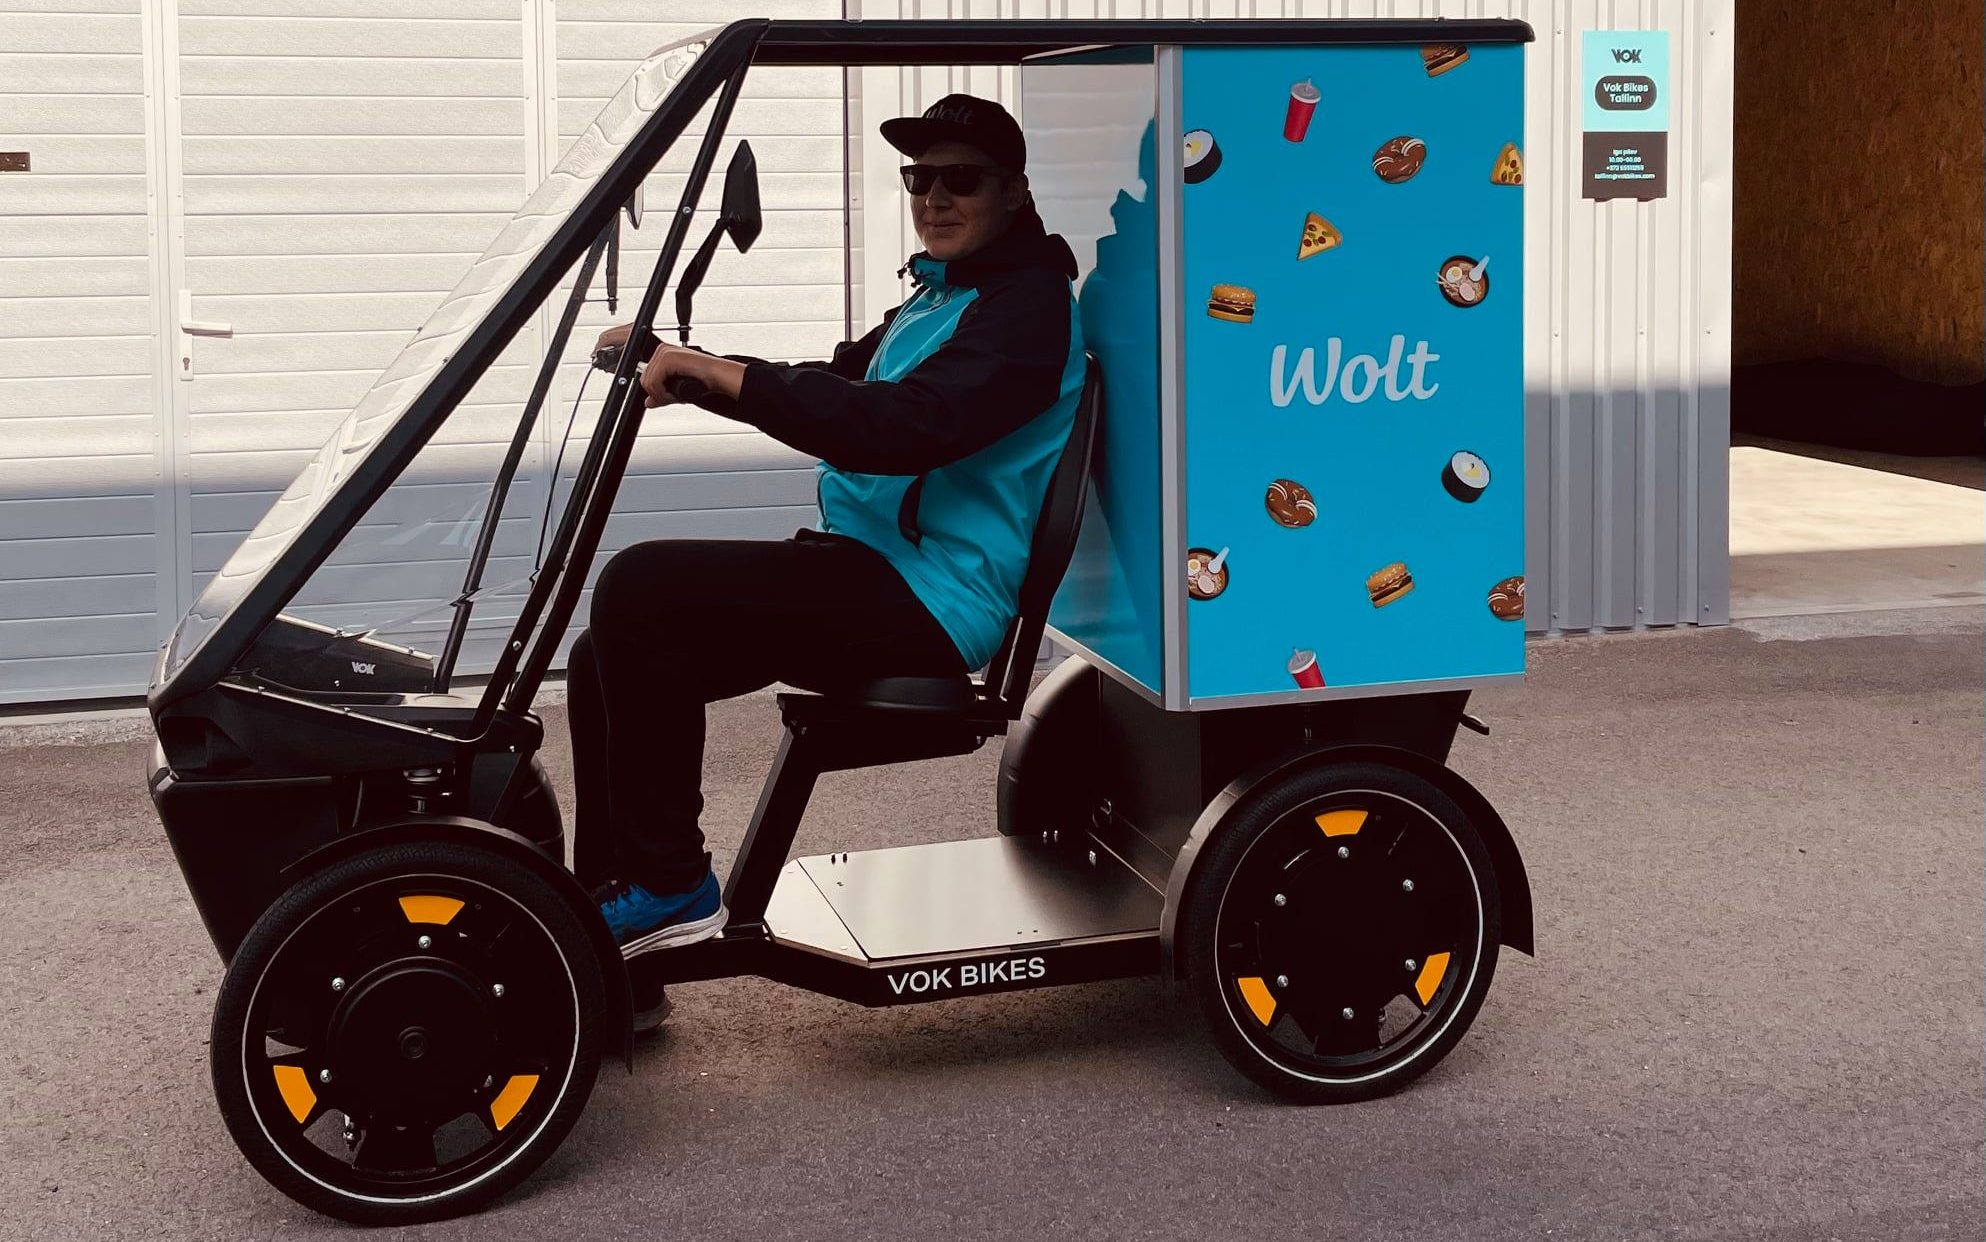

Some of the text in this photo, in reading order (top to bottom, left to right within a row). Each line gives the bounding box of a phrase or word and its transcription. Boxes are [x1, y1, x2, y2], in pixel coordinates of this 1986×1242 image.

[1611, 49, 1642, 63] VOK
[1603, 83, 1649, 92] Vok Bikes
[1610, 94, 1642, 103] Tallinn
[1270, 334, 1441, 407] Wolt
[351, 661, 376, 675] VOK
[887, 956, 1046, 995] VOK BIKES
